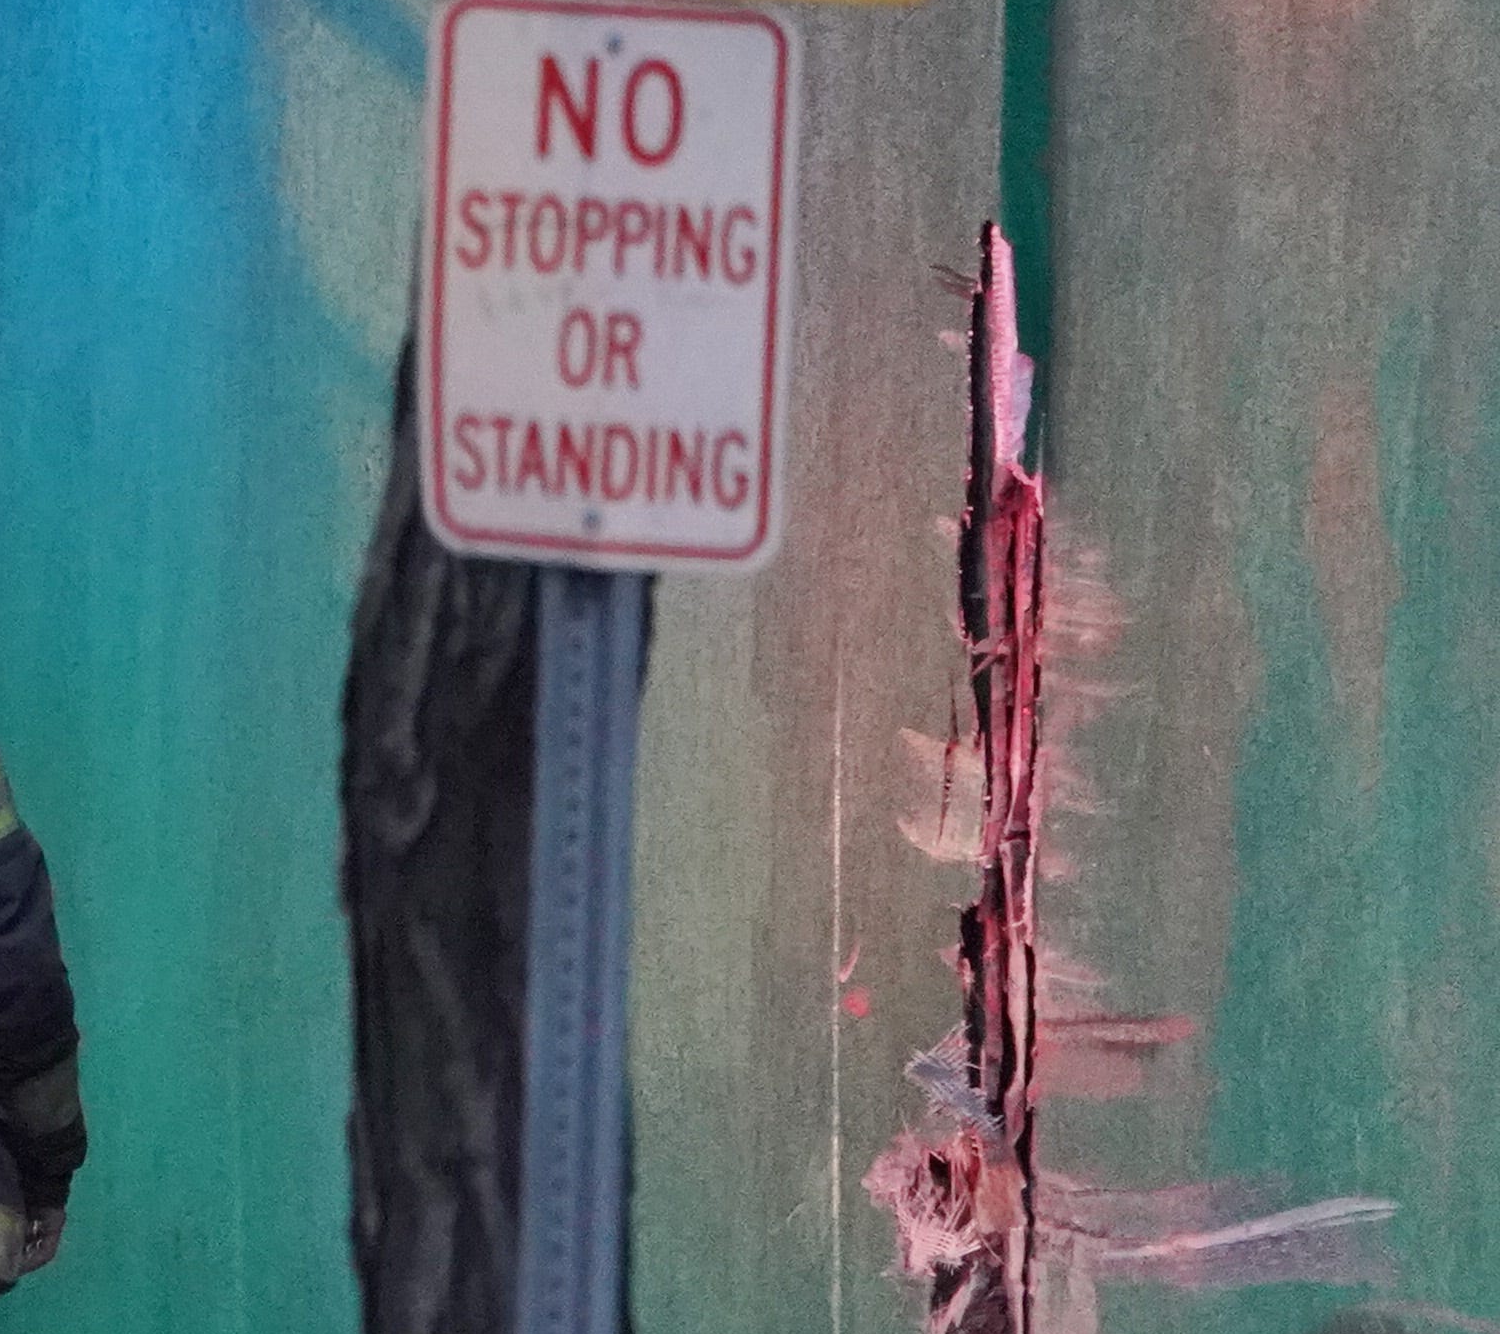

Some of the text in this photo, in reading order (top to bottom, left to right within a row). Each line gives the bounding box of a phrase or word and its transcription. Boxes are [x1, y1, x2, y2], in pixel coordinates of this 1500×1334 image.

[536, 52, 686, 167] NO
[456, 189, 758, 287] STOPPING
[557, 307, 644, 391] OR
[452, 413, 750, 510] STANDING
